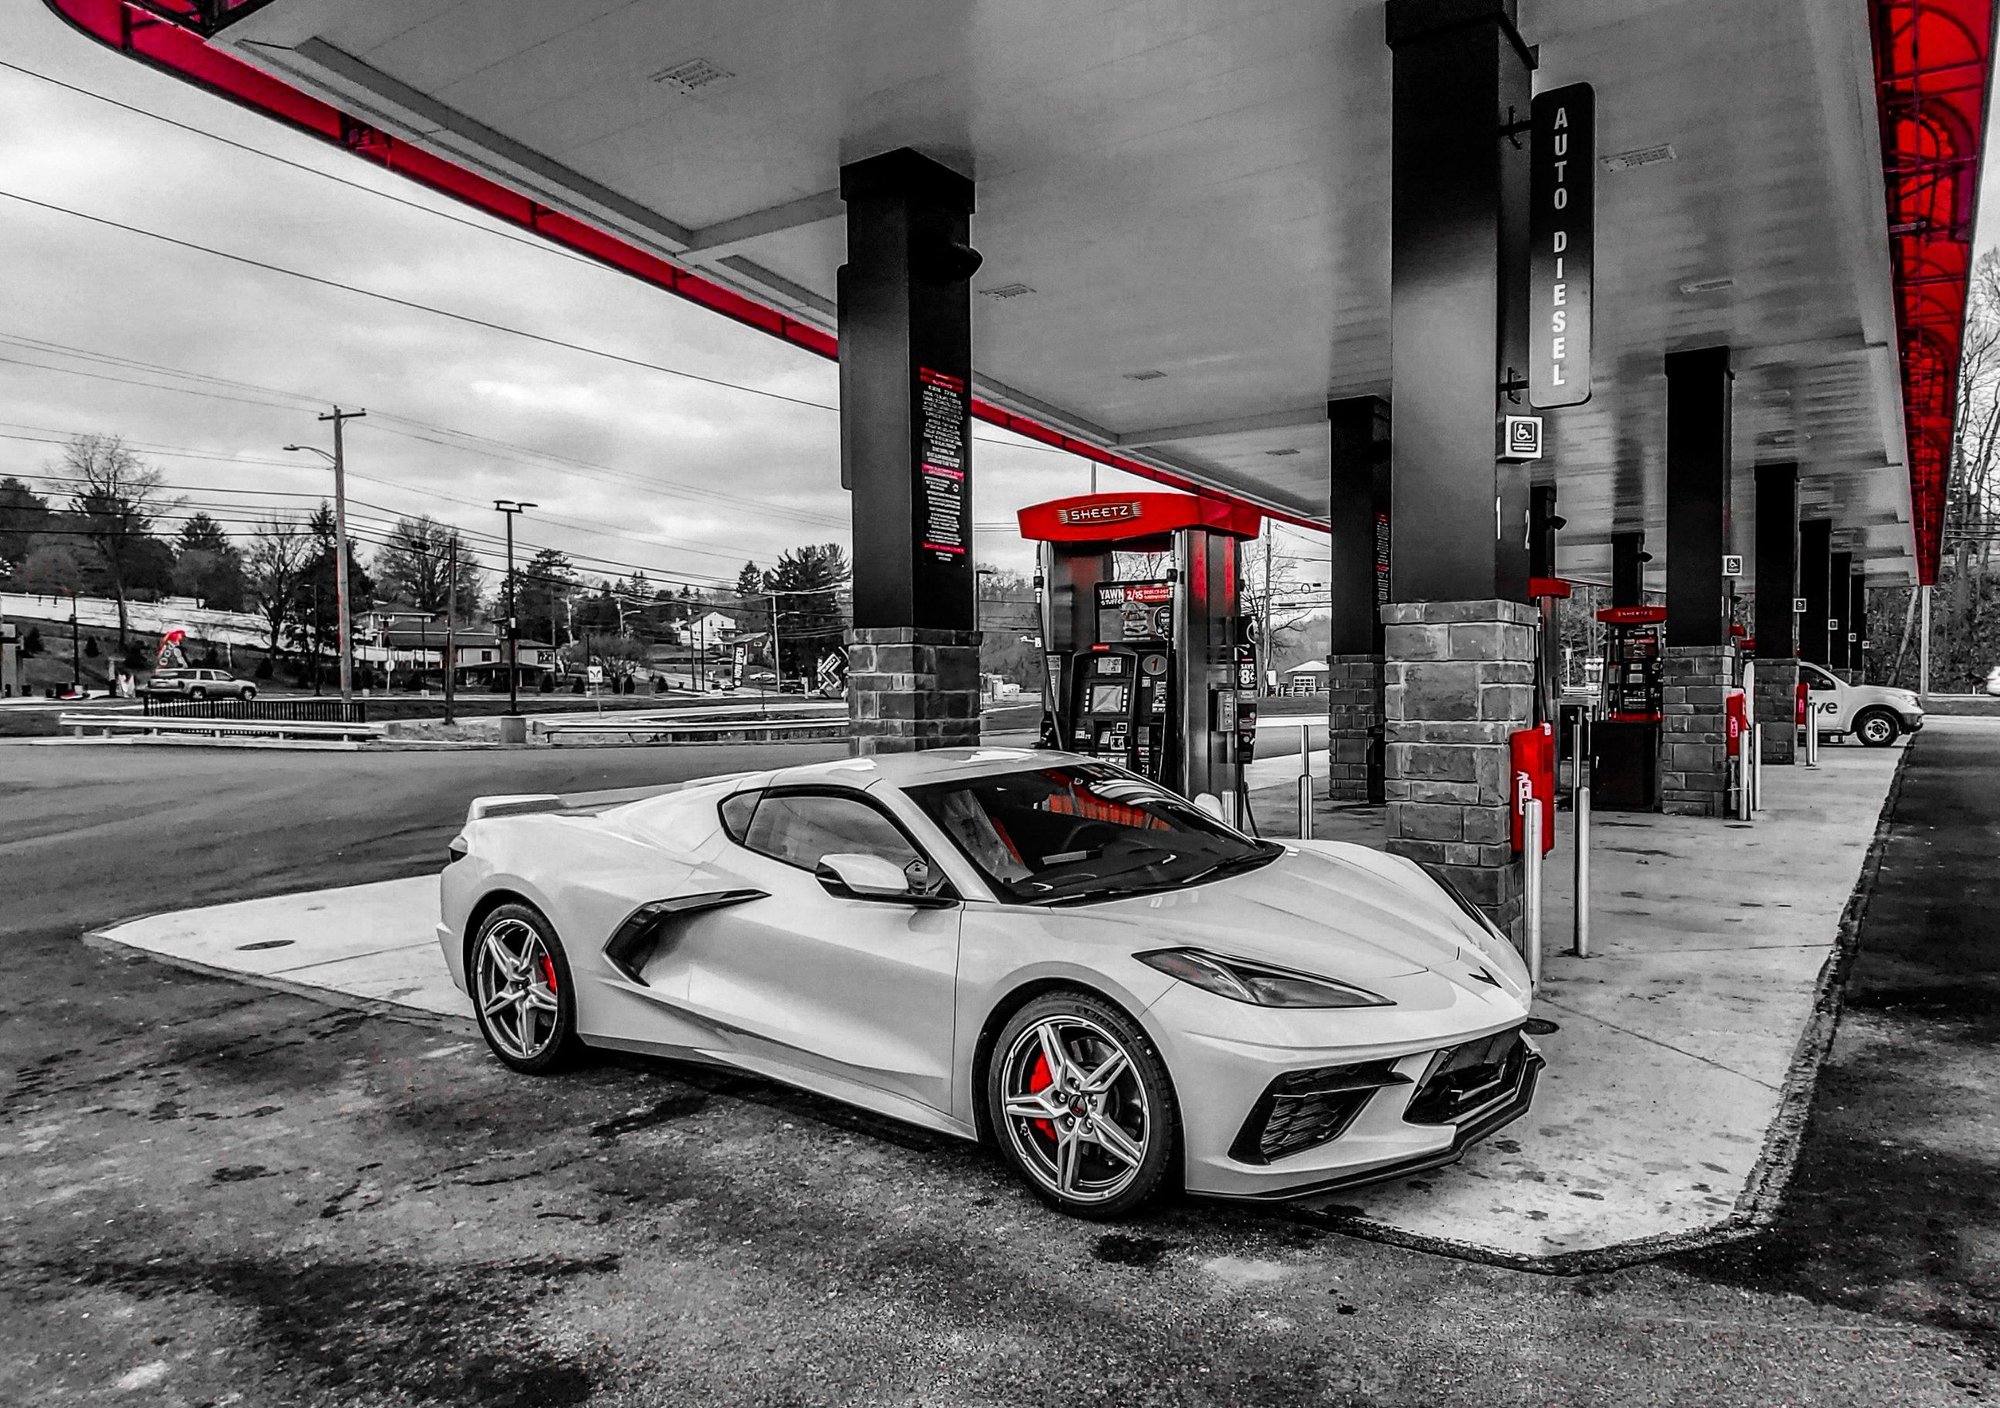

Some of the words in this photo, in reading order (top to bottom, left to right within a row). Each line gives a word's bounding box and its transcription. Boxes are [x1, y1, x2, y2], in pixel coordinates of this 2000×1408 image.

[1553, 107, 1568, 210] AUTO
[1552, 230, 1567, 387] DIESEL
[1071, 505, 1129, 520] SHEETZ
[1099, 588, 1125, 601] YAWN
[734, 647, 744, 664] OPEN
[1151, 658, 1159, 671] 1
